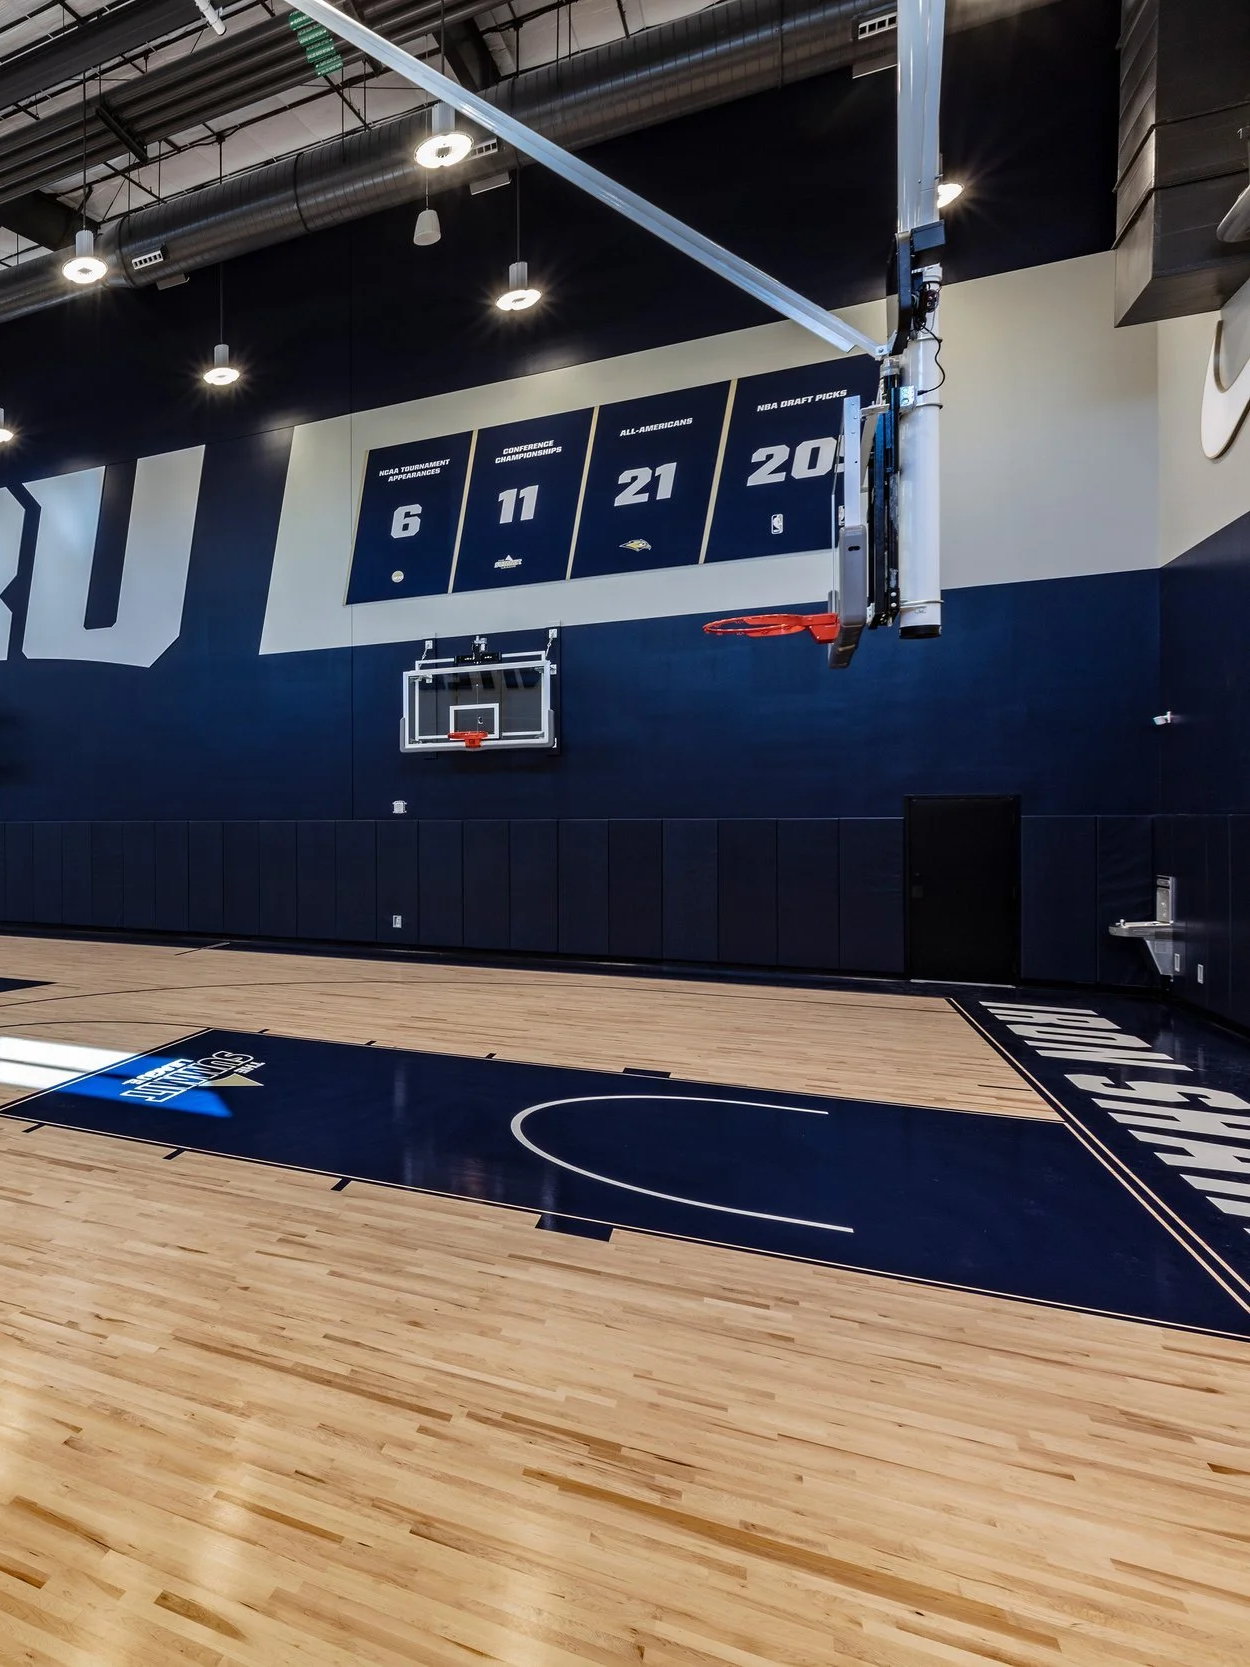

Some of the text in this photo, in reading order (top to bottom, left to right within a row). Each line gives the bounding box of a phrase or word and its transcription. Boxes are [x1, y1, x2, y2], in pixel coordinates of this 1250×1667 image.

[757, 389, 848, 412] NBA DRAFT PICKS
[619, 417, 693, 437] ALL-AMERICANS
[495, 446, 562, 464] CHAMPIONSHIPS
[503, 440, 554, 455] CONFERENCE
[746, 436, 837, 487] 20
[379, 458, 451, 477] NCAA TOURNAMENT
[388, 467, 441, 482] APPEARANCES
[614, 462, 677, 507] 21
[498, 485, 539, 524] 11
[390, 503, 422, 539] 6
[978, 1000, 1194, 1072] IRON
[119, 1050, 254, 1103] SUMMIT
